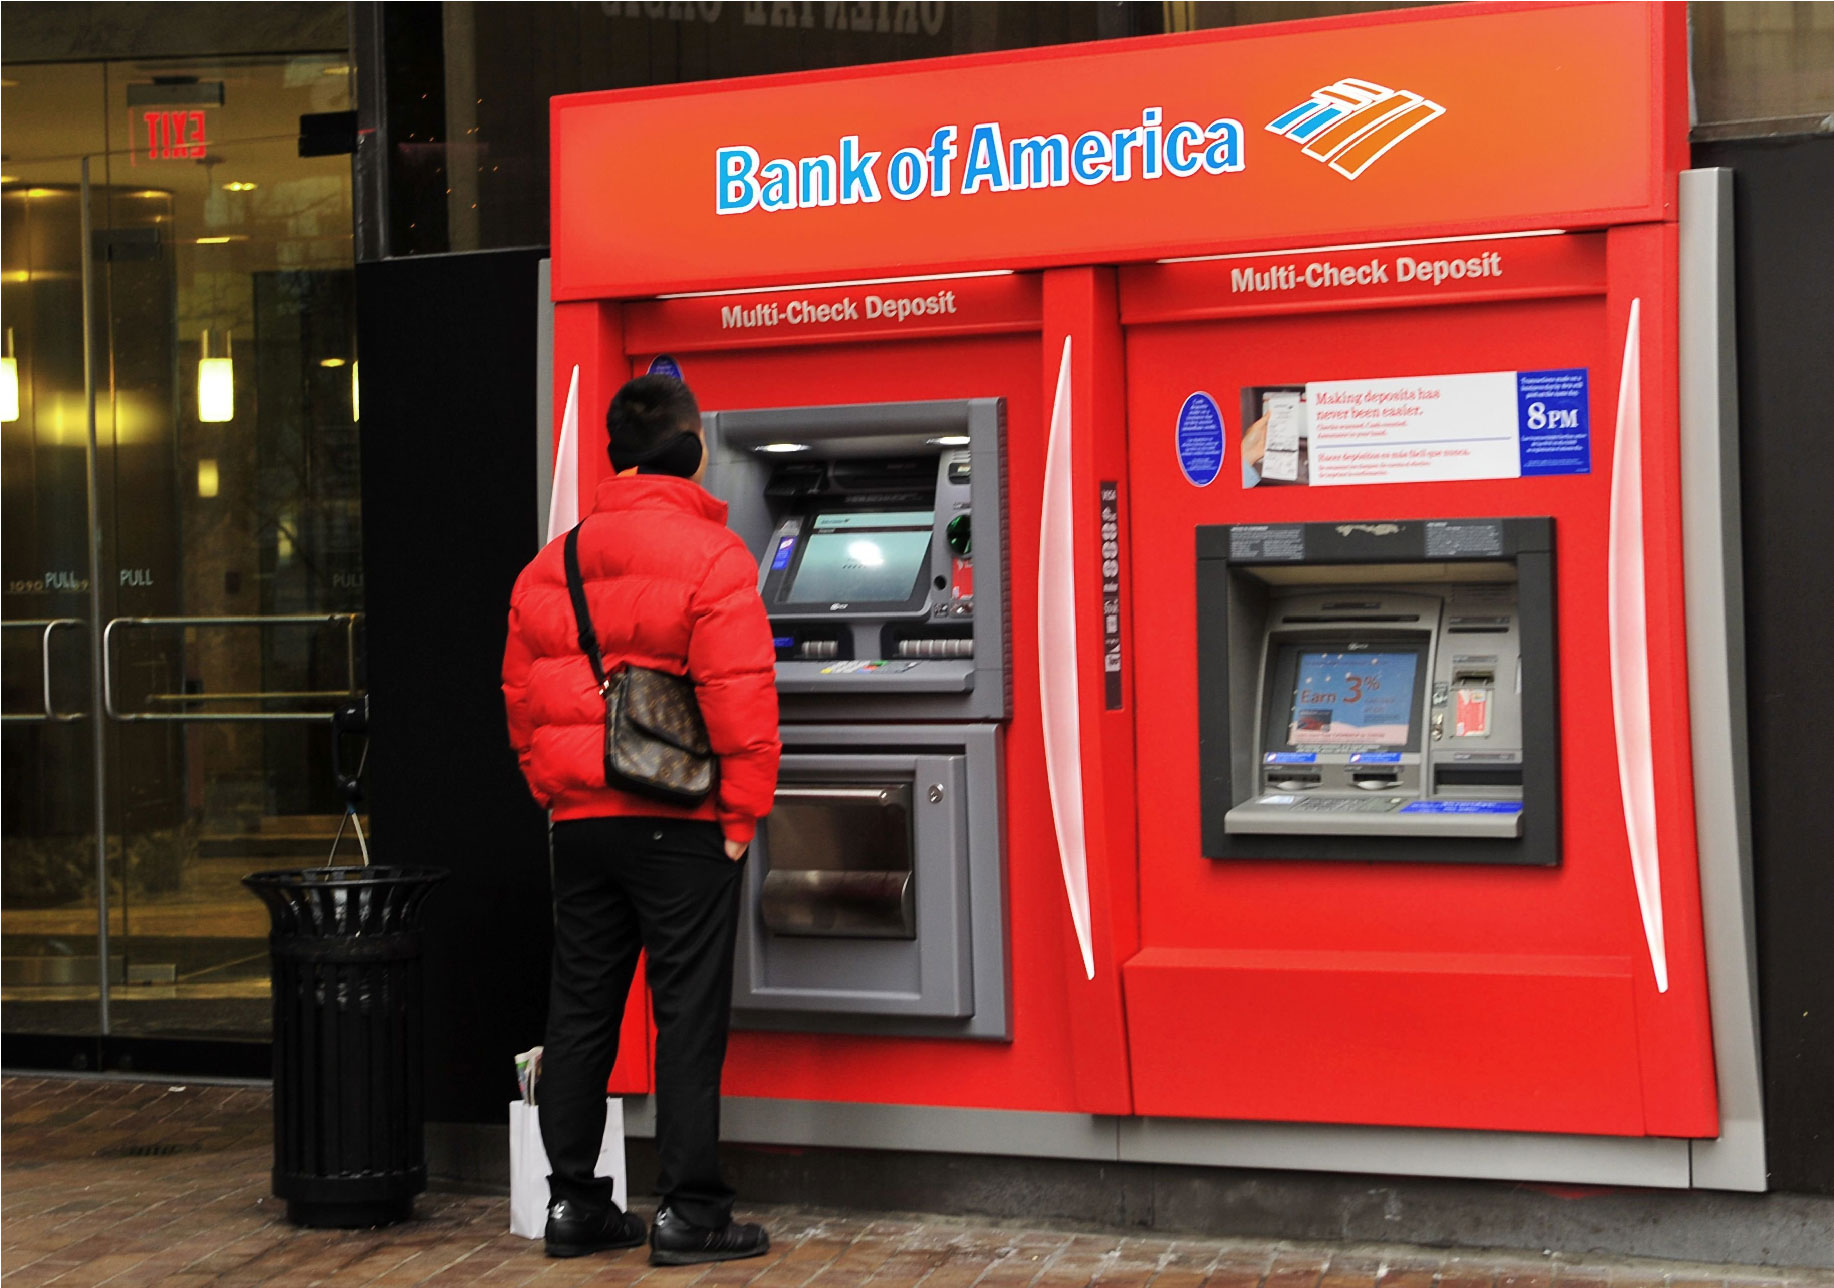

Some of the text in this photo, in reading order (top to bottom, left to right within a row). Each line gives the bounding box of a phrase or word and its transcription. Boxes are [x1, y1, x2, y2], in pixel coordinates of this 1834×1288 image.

[715, 106, 1245, 215] Bank of America
[1230, 251, 1502, 293] Multi-Check Deposit
[720, 290, 957, 329] Multi-Check Deposit
[1316, 386, 1441, 406] Making deposits has
[1316, 409, 1349, 421] never
[1350, 406, 1381, 419] been
[45, 571, 76, 589] PULL
[120, 569, 153, 586] PULL
[1300, 689, 1337, 704] Earn
